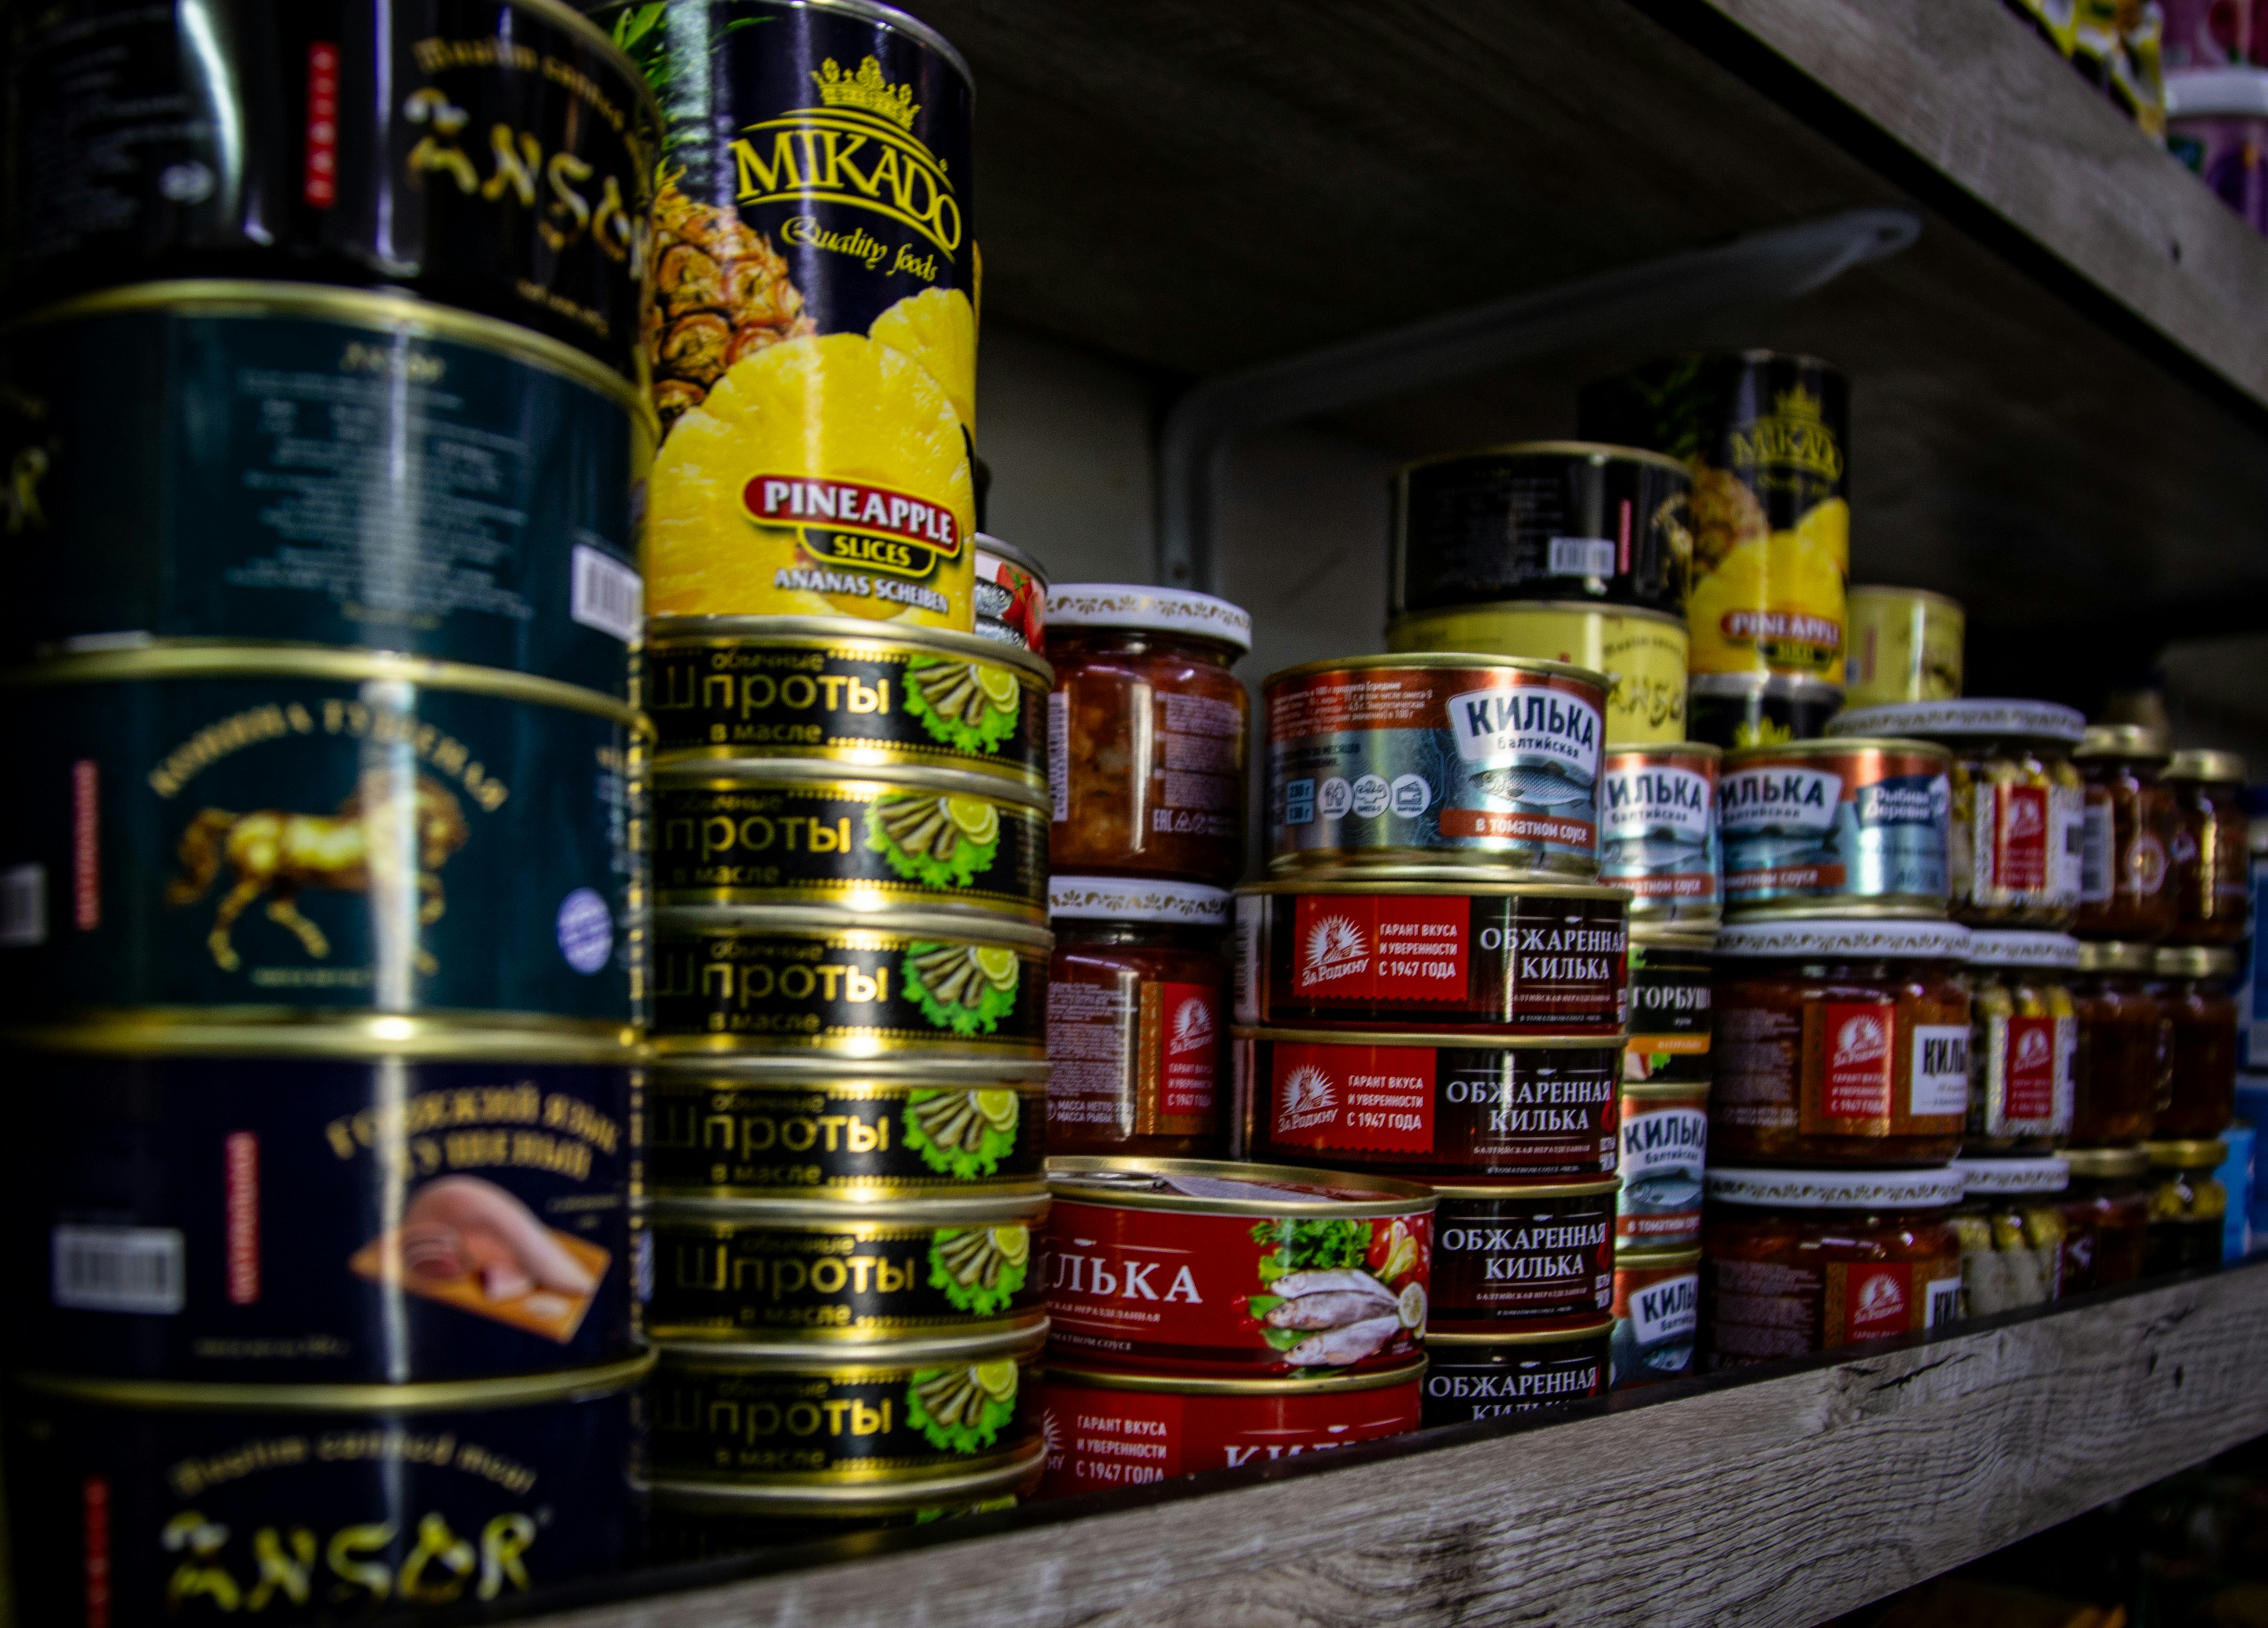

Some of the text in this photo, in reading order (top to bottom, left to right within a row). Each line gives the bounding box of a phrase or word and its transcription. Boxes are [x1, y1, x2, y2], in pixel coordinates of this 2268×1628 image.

[729, 129, 962, 250] MIKADO
[780, 215, 938, 282] Quality foods
[763, 480, 954, 546] PINEAPPLE
[833, 534, 911, 568] SLICES
[773, 566, 950, 615] ANANAS SCHEIBEN
[652, 665, 890, 720] Шпроты
[1466, 695, 1594, 752] КИЛЬКА
[1498, 736, 1580, 759] балтийская
[1607, 773, 1702, 813] ИЛЬКА
[666, 815, 851, 862] проты
[1379, 923, 1457, 937] ГАРАНТ ВКУСА
[1480, 928, 1626, 953] ОБЖАРЕННАЯ
[1379, 942, 1457, 956] И УВЕРЕННОСТИ
[1379, 961, 1457, 979] С 1947 ГОДА
[1520, 957, 1610, 980] КИЛЬКА
[1348, 1075, 1424, 1090] ГАРАНТ ВКУСА
[1446, 1081, 1611, 1103] ОБЖАРЕННАЯ
[1348, 1094, 1424, 1108] И УВЕРЕННОСТИ
[1347, 1112, 1422, 1131] С 1947 ГОДА
[1488, 1109, 1590, 1132] КИЛЬКА
[1442, 1222, 1606, 1252] ОБЖАРЕННАЯ
[676, 1245, 914, 1301] Шпроты
[1053, 1253, 1203, 1304] ЛЬКА
[1484, 1254, 1584, 1280] КИЛЬКА
[1428, 1367, 1597, 1398] ОБЖАРЕННАЯ
[1078, 1415, 1167, 1436] ГАРАНТ ВКУСА
[1077, 1439, 1167, 1459] И УВЕРЕННОСТИ
[1075, 1461, 1085, 1477] С
[1090, 1462, 1120, 1482] 1947
